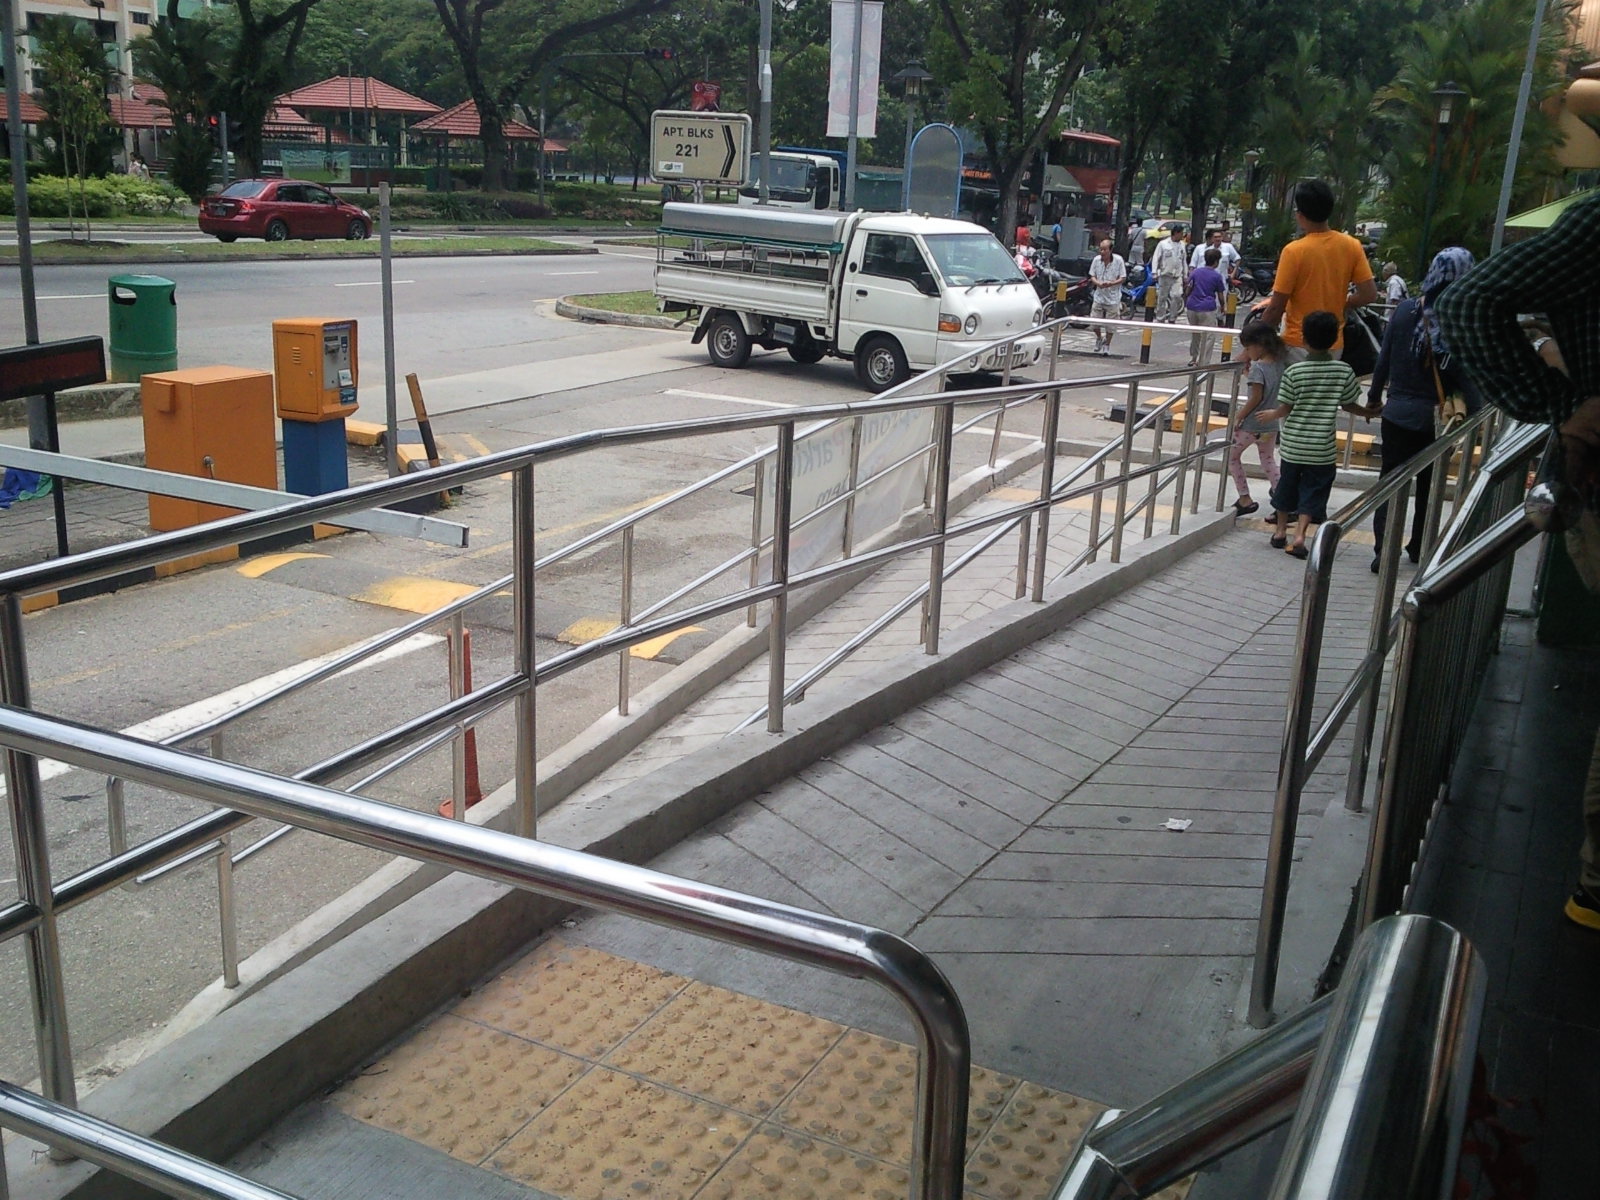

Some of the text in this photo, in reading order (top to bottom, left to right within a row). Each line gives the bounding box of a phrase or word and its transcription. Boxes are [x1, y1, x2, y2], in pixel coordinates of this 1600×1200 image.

[663, 127, 714, 139] APT. BLKS
[675, 144, 699, 157] 221
